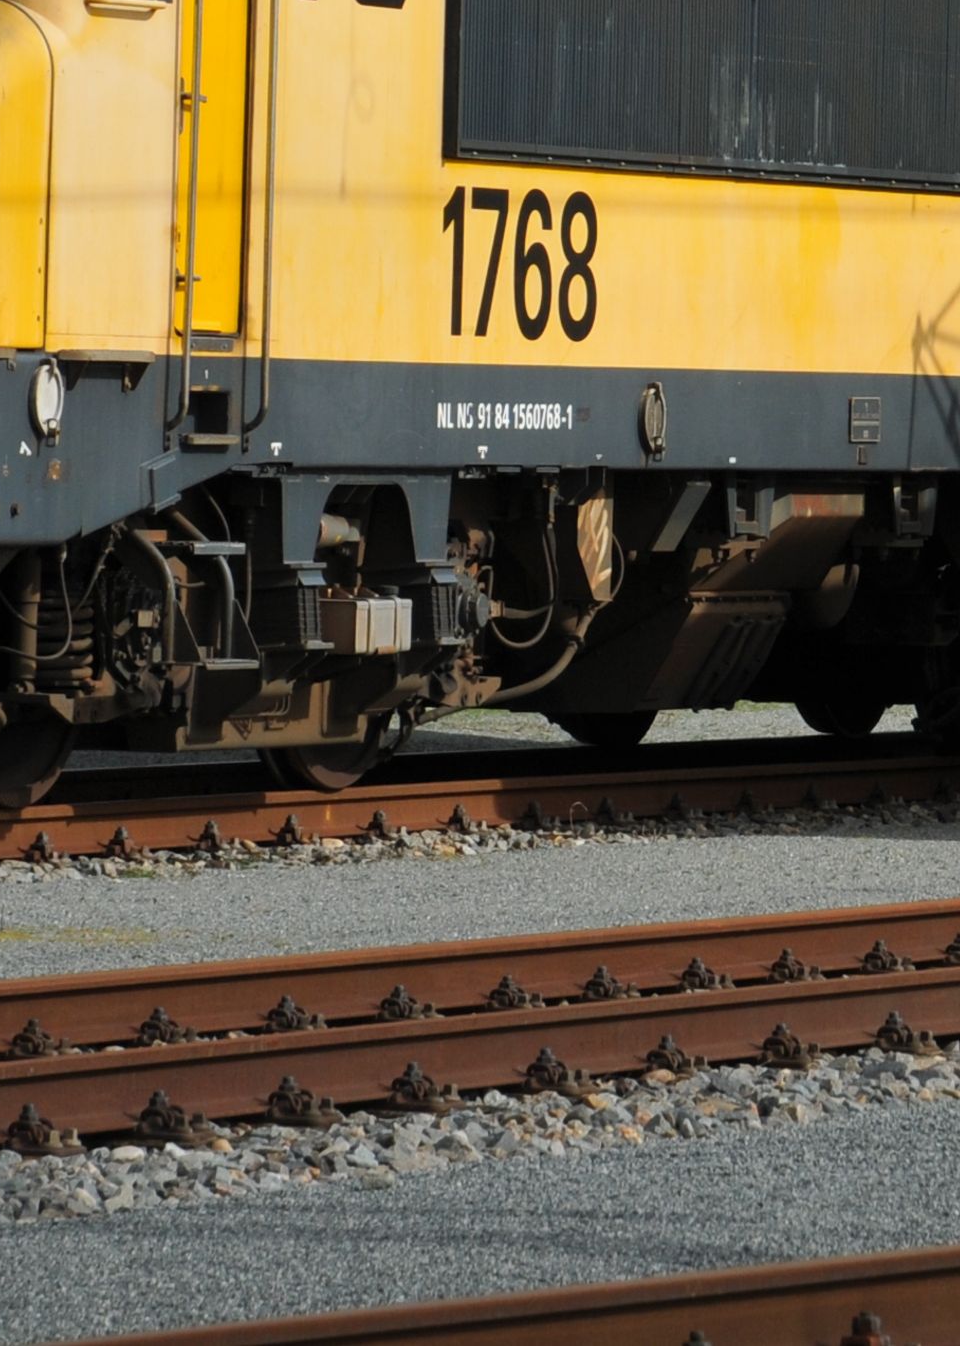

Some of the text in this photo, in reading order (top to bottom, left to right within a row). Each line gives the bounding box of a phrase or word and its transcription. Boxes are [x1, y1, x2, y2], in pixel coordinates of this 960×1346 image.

[443, 185, 598, 342] 1768
[437, 402, 573, 430] NL NS 91 84 1560768-1
